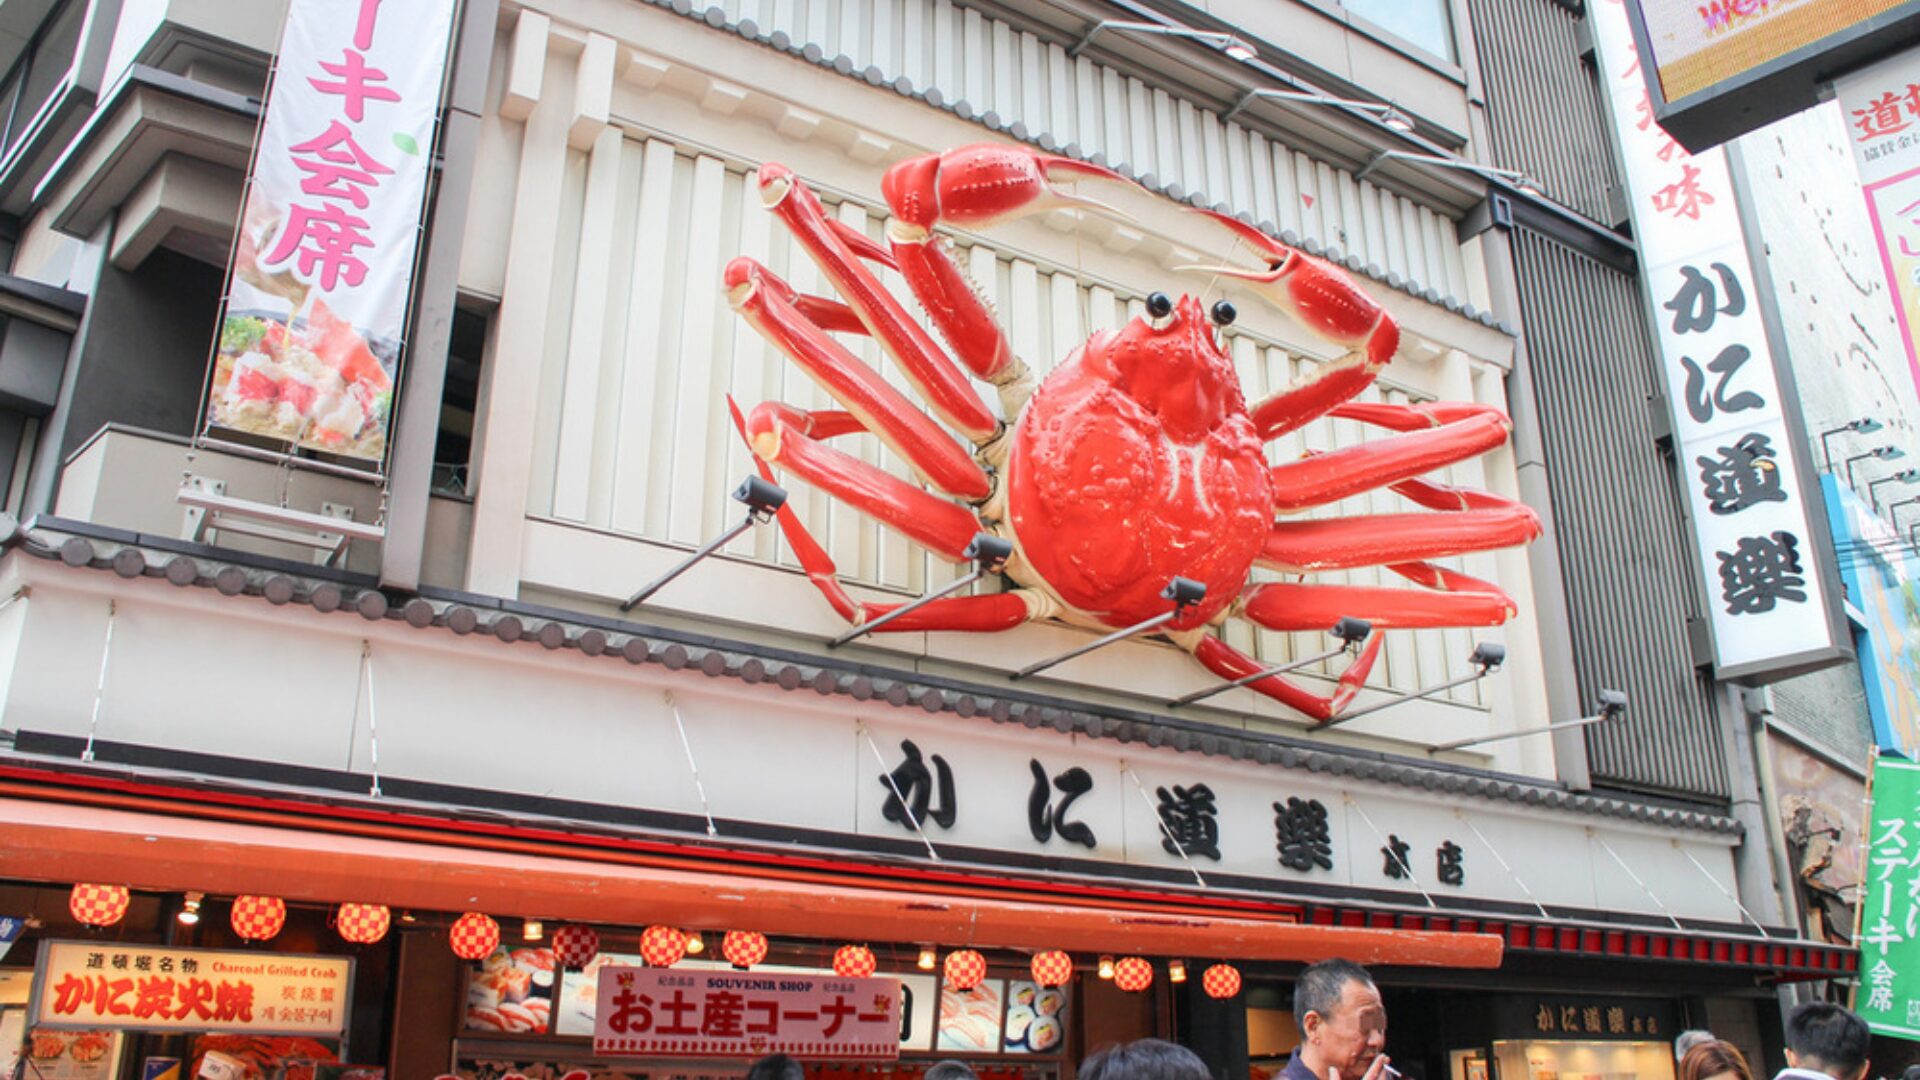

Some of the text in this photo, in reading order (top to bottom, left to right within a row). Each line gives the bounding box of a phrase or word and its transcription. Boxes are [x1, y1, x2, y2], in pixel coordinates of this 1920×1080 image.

[1866, 818, 1909, 1013] ステーキ会席
[86, 952, 198, 974] 道頓堀名物
[212, 962, 337, 979] Charcoal Grilled Crab
[54, 972, 254, 1023] かに炭火焼
[706, 977, 814, 993] SOUVENIR SHOP
[608, 989, 890, 1038] お土産コーナー
